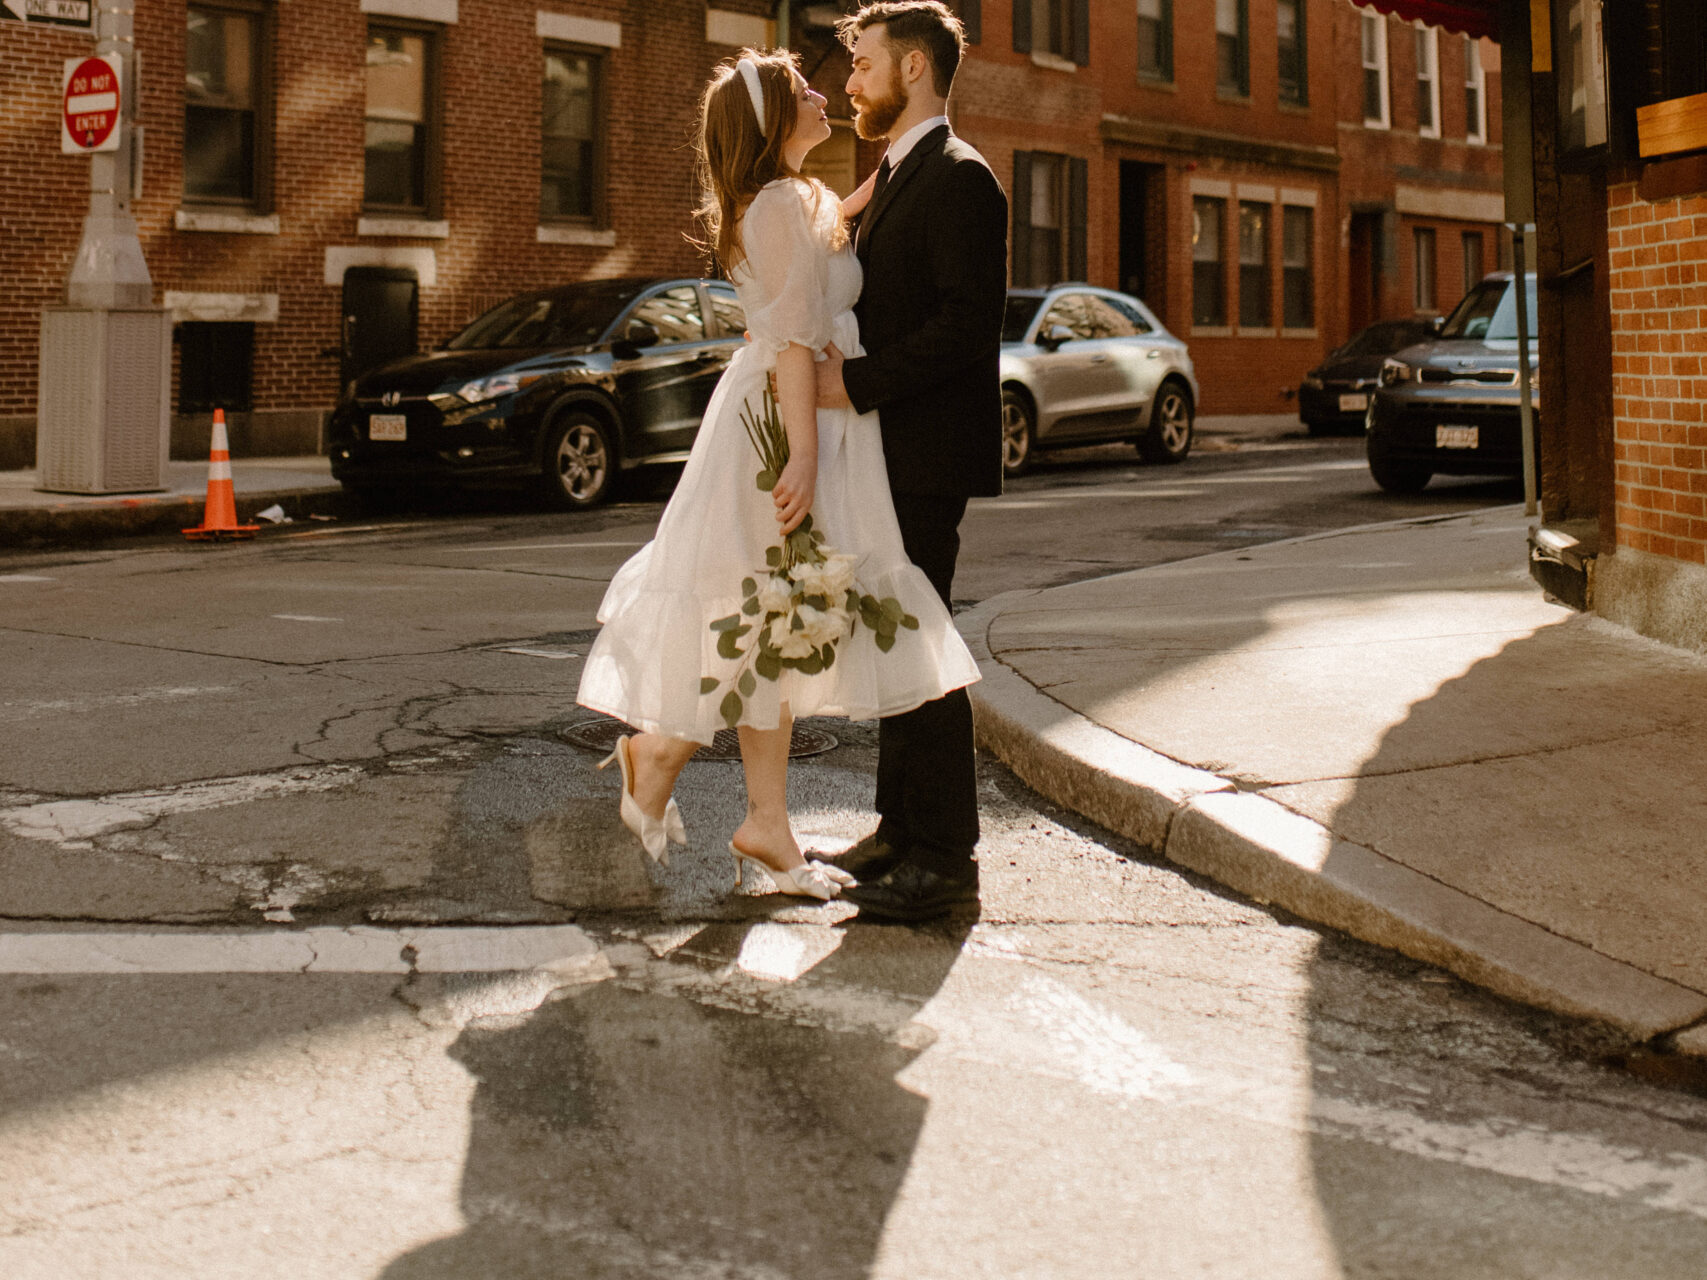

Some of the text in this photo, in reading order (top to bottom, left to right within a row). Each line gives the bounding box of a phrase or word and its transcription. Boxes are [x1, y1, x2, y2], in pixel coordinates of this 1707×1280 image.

[57, 2, 82, 17] WAY
[73, 73, 111, 94] DO NOT
[75, 113, 107, 132] ENTER
